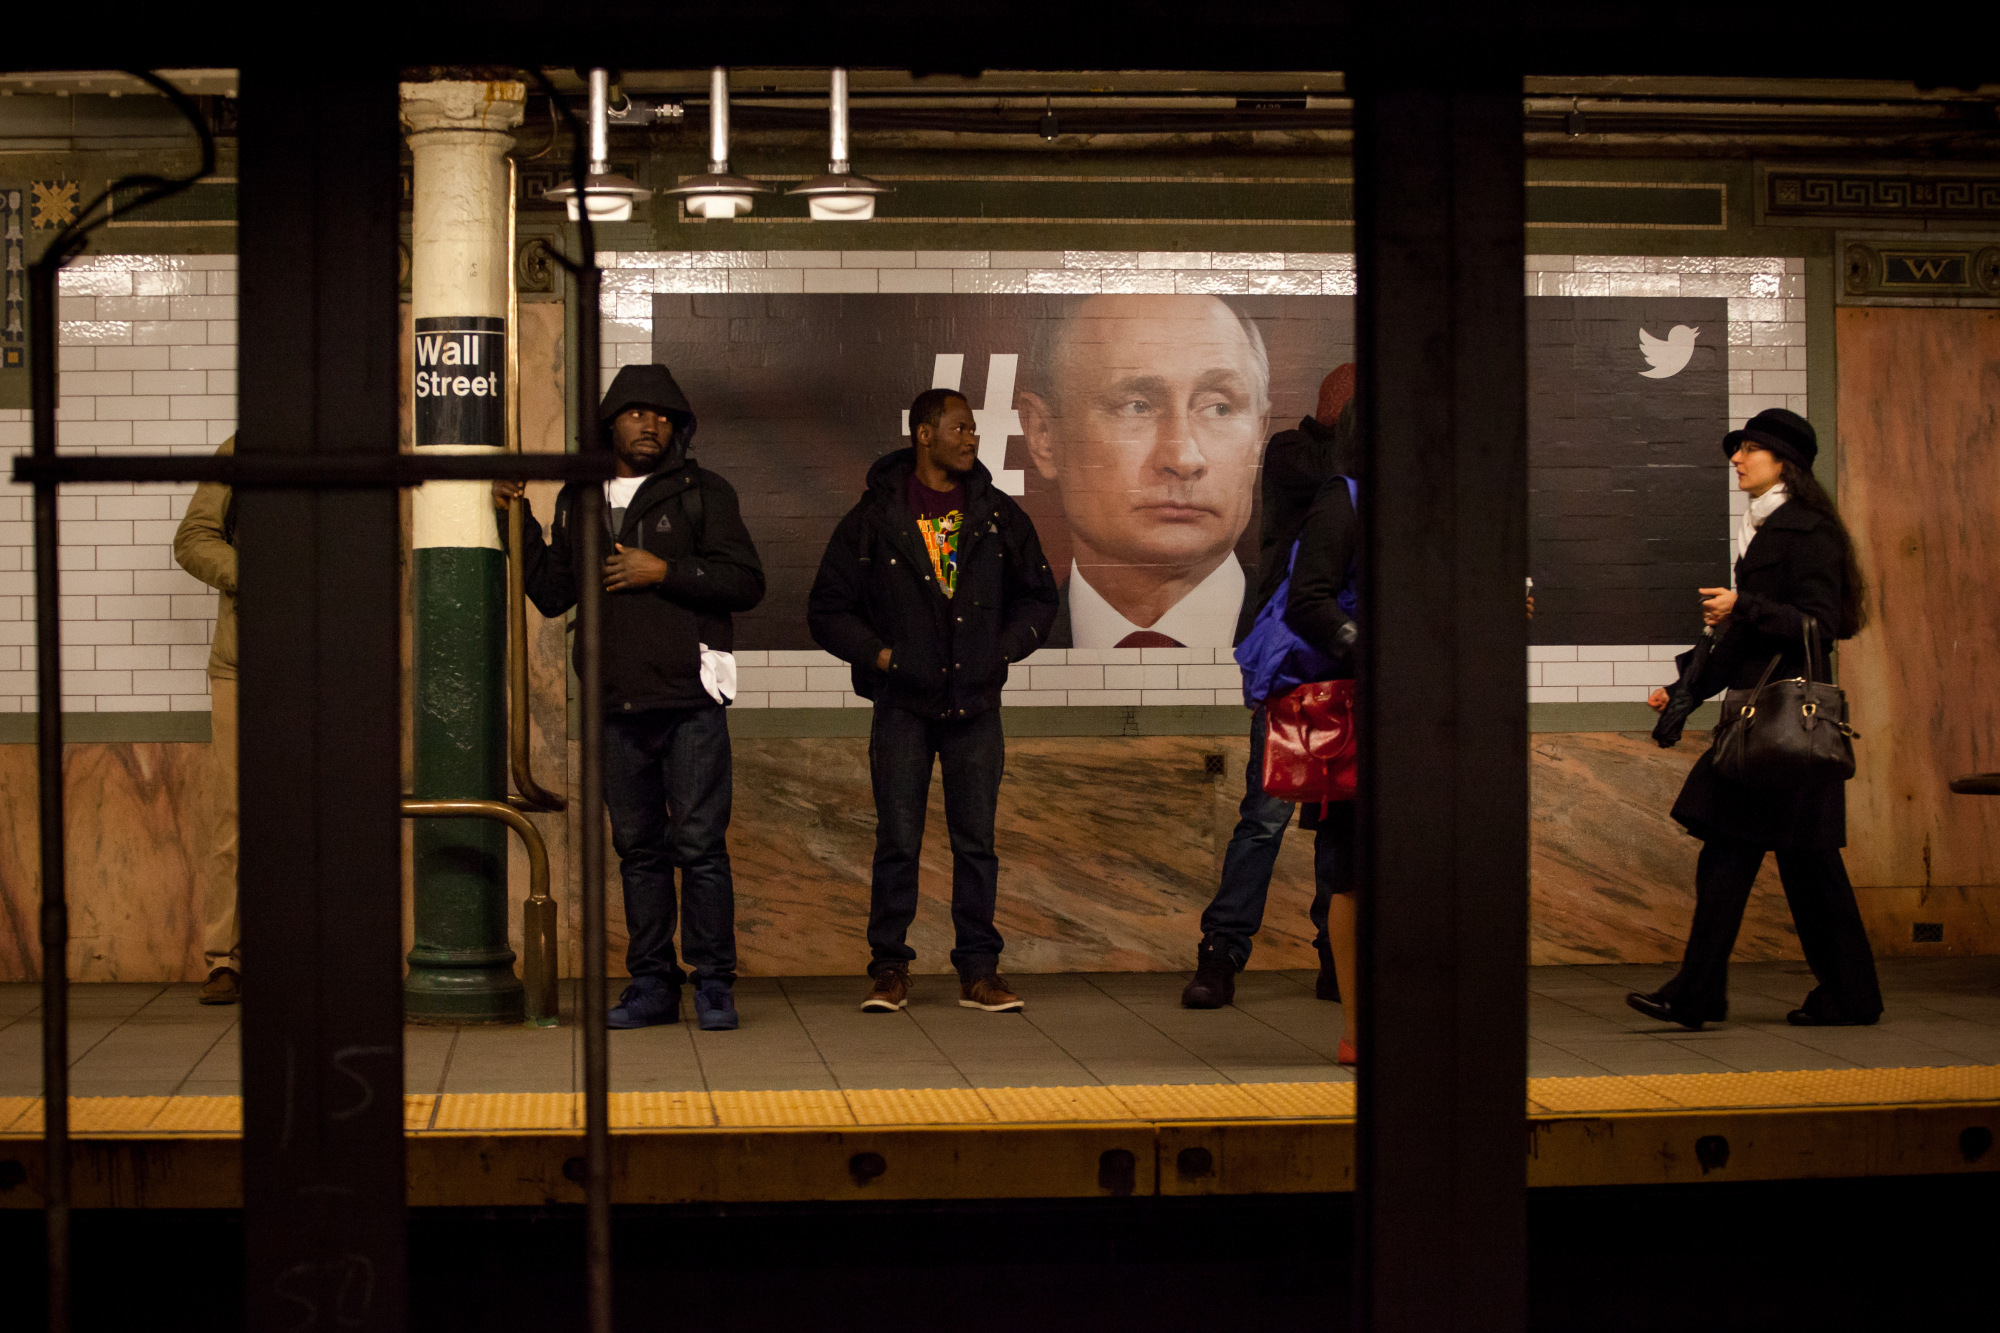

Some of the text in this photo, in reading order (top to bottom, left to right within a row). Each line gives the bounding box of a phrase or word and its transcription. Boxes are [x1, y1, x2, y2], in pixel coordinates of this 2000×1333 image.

[1903, 259, 1950, 280] W
[416, 335, 479, 366] Wall
[416, 371, 498, 398] Street
